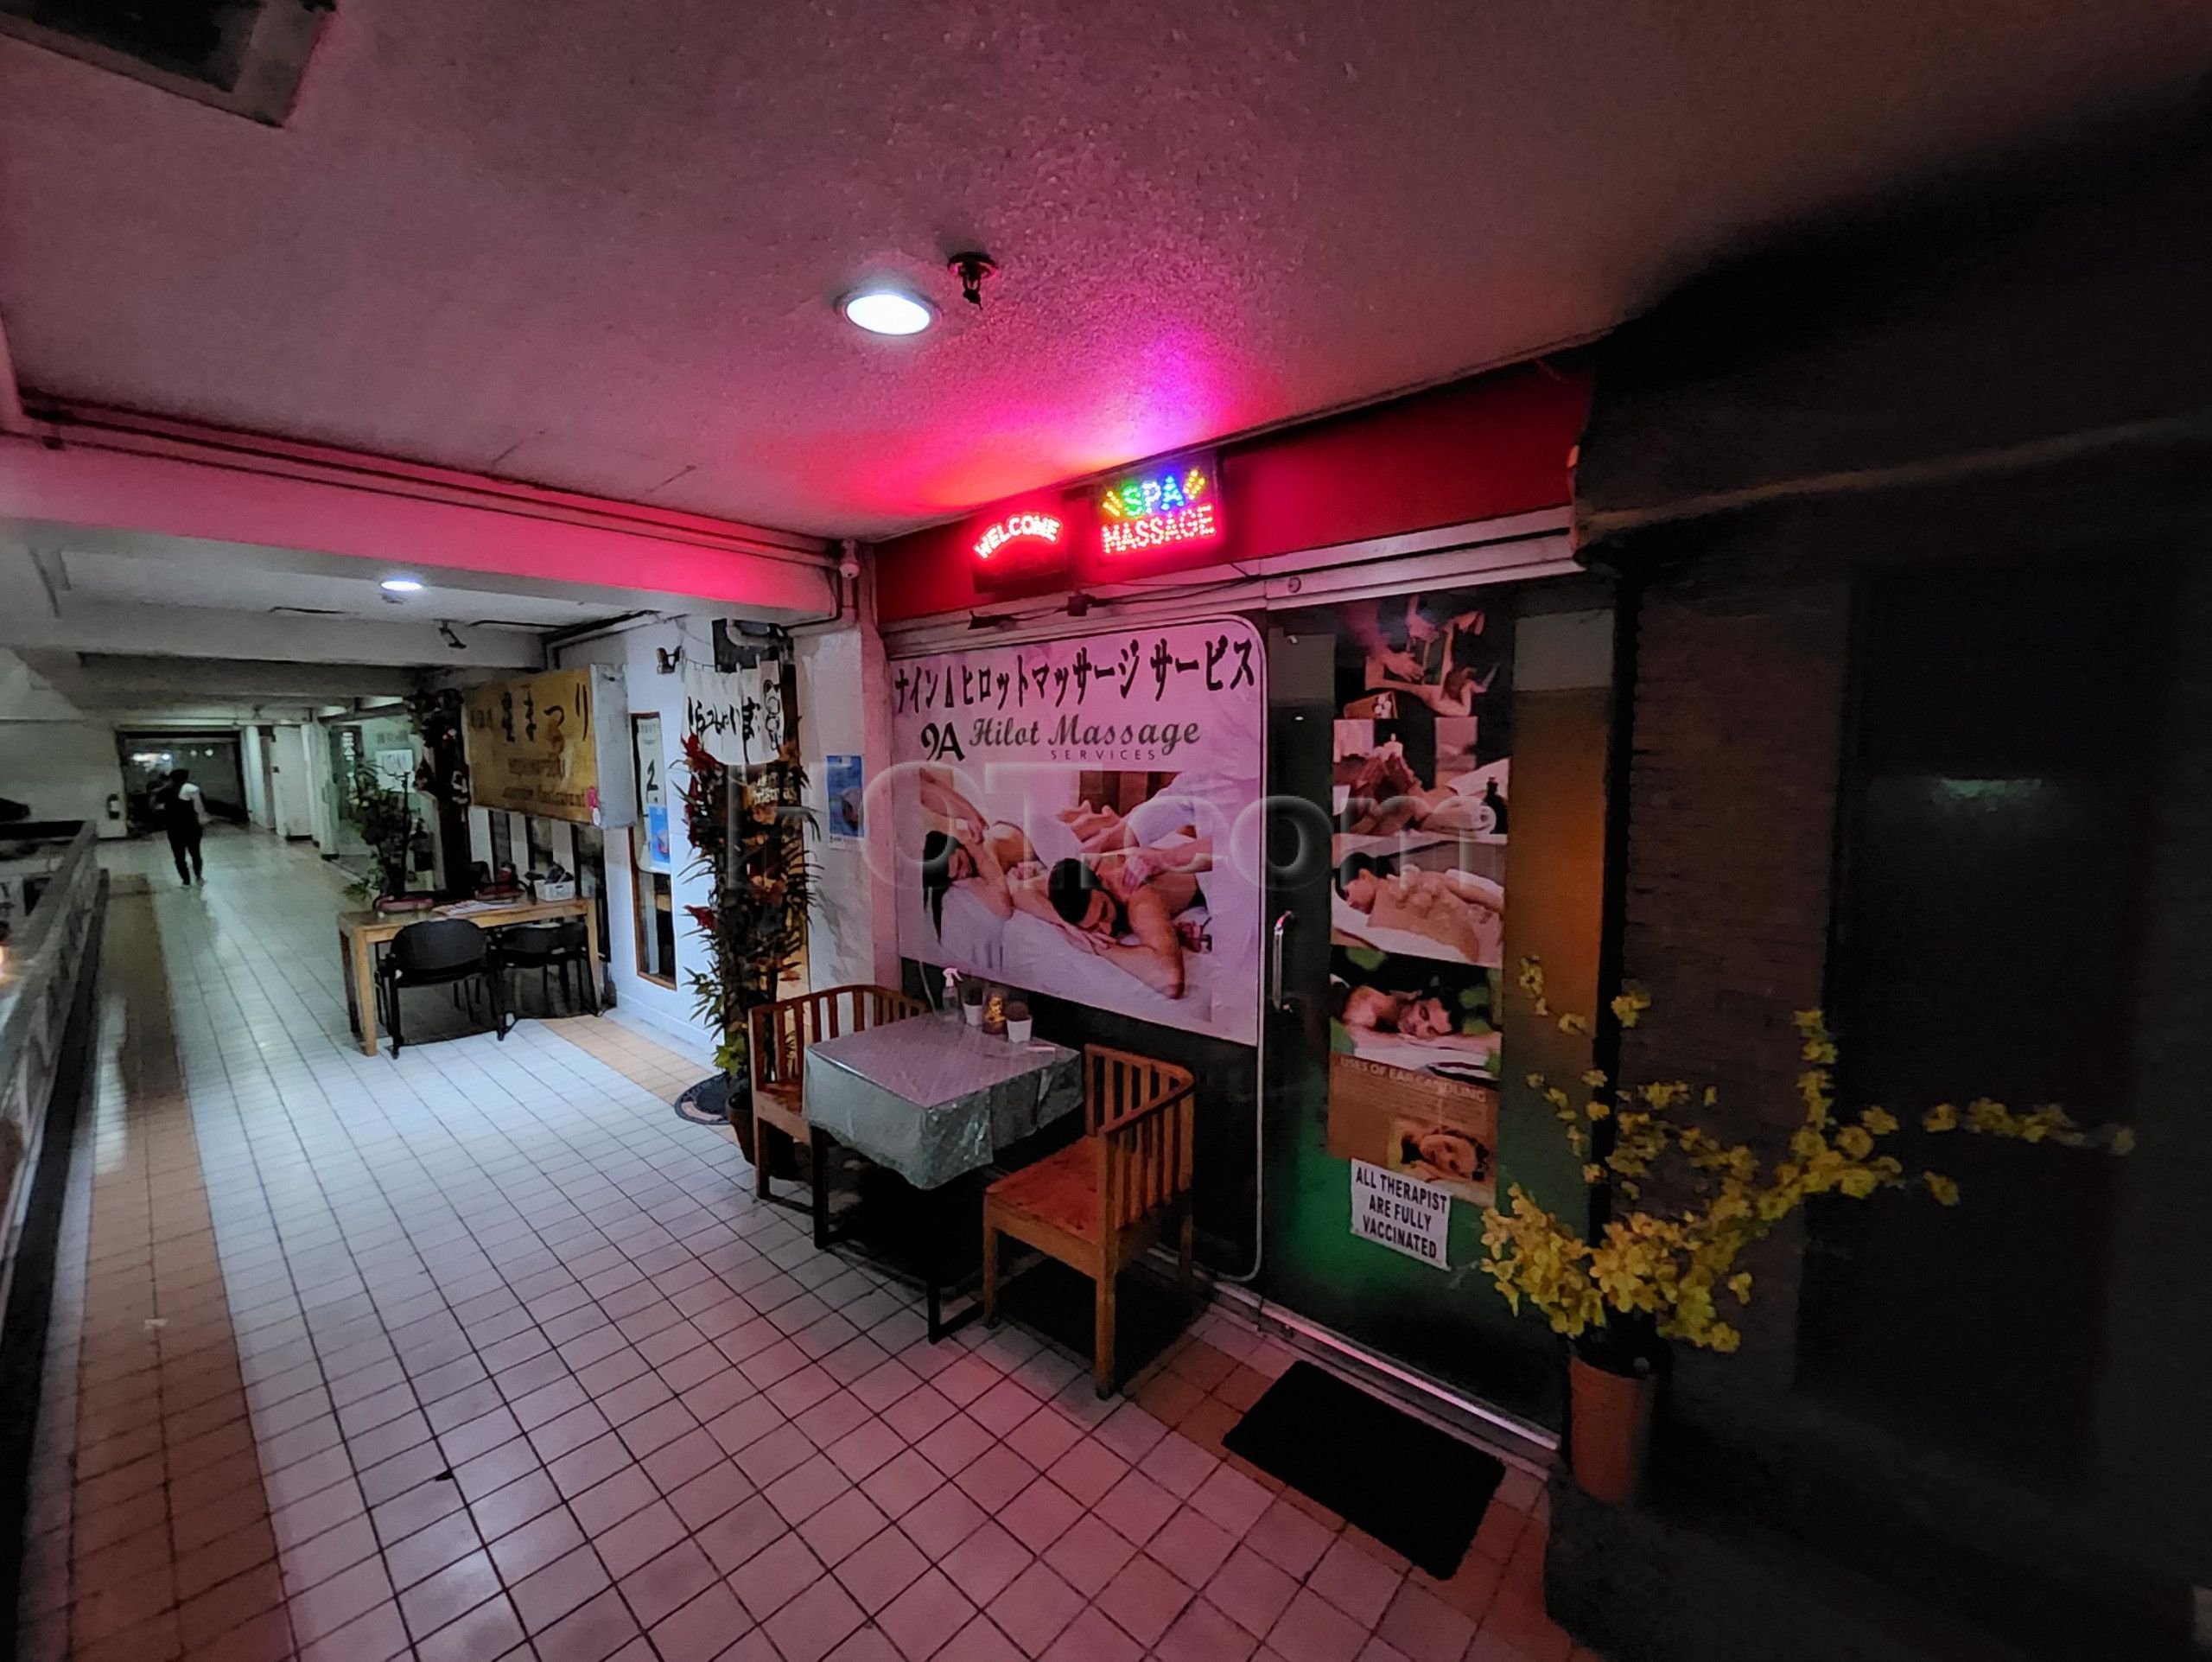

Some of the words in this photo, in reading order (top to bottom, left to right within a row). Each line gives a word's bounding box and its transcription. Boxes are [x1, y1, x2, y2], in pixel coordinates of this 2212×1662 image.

[1122, 474, 1185, 517] SPA
[974, 513, 1061, 560] WELCOME
[1102, 504, 1216, 554] MASSAGE
[919, 721, 965, 761] 9A
[969, 716, 1040, 747] Hilot
[1047, 714, 1202, 756] Massage
[1050, 748, 1156, 761] SERVICES
[1370, 1064, 1387, 1076] OF
[1356, 1166, 1376, 1189] ALL
[1380, 1173, 1447, 1214] THERAPIST
[1369, 1194, 1391, 1219] ARE
[1394, 1203, 1432, 1232] FULLY
[1363, 1214, 1437, 1259] VACCINATED
